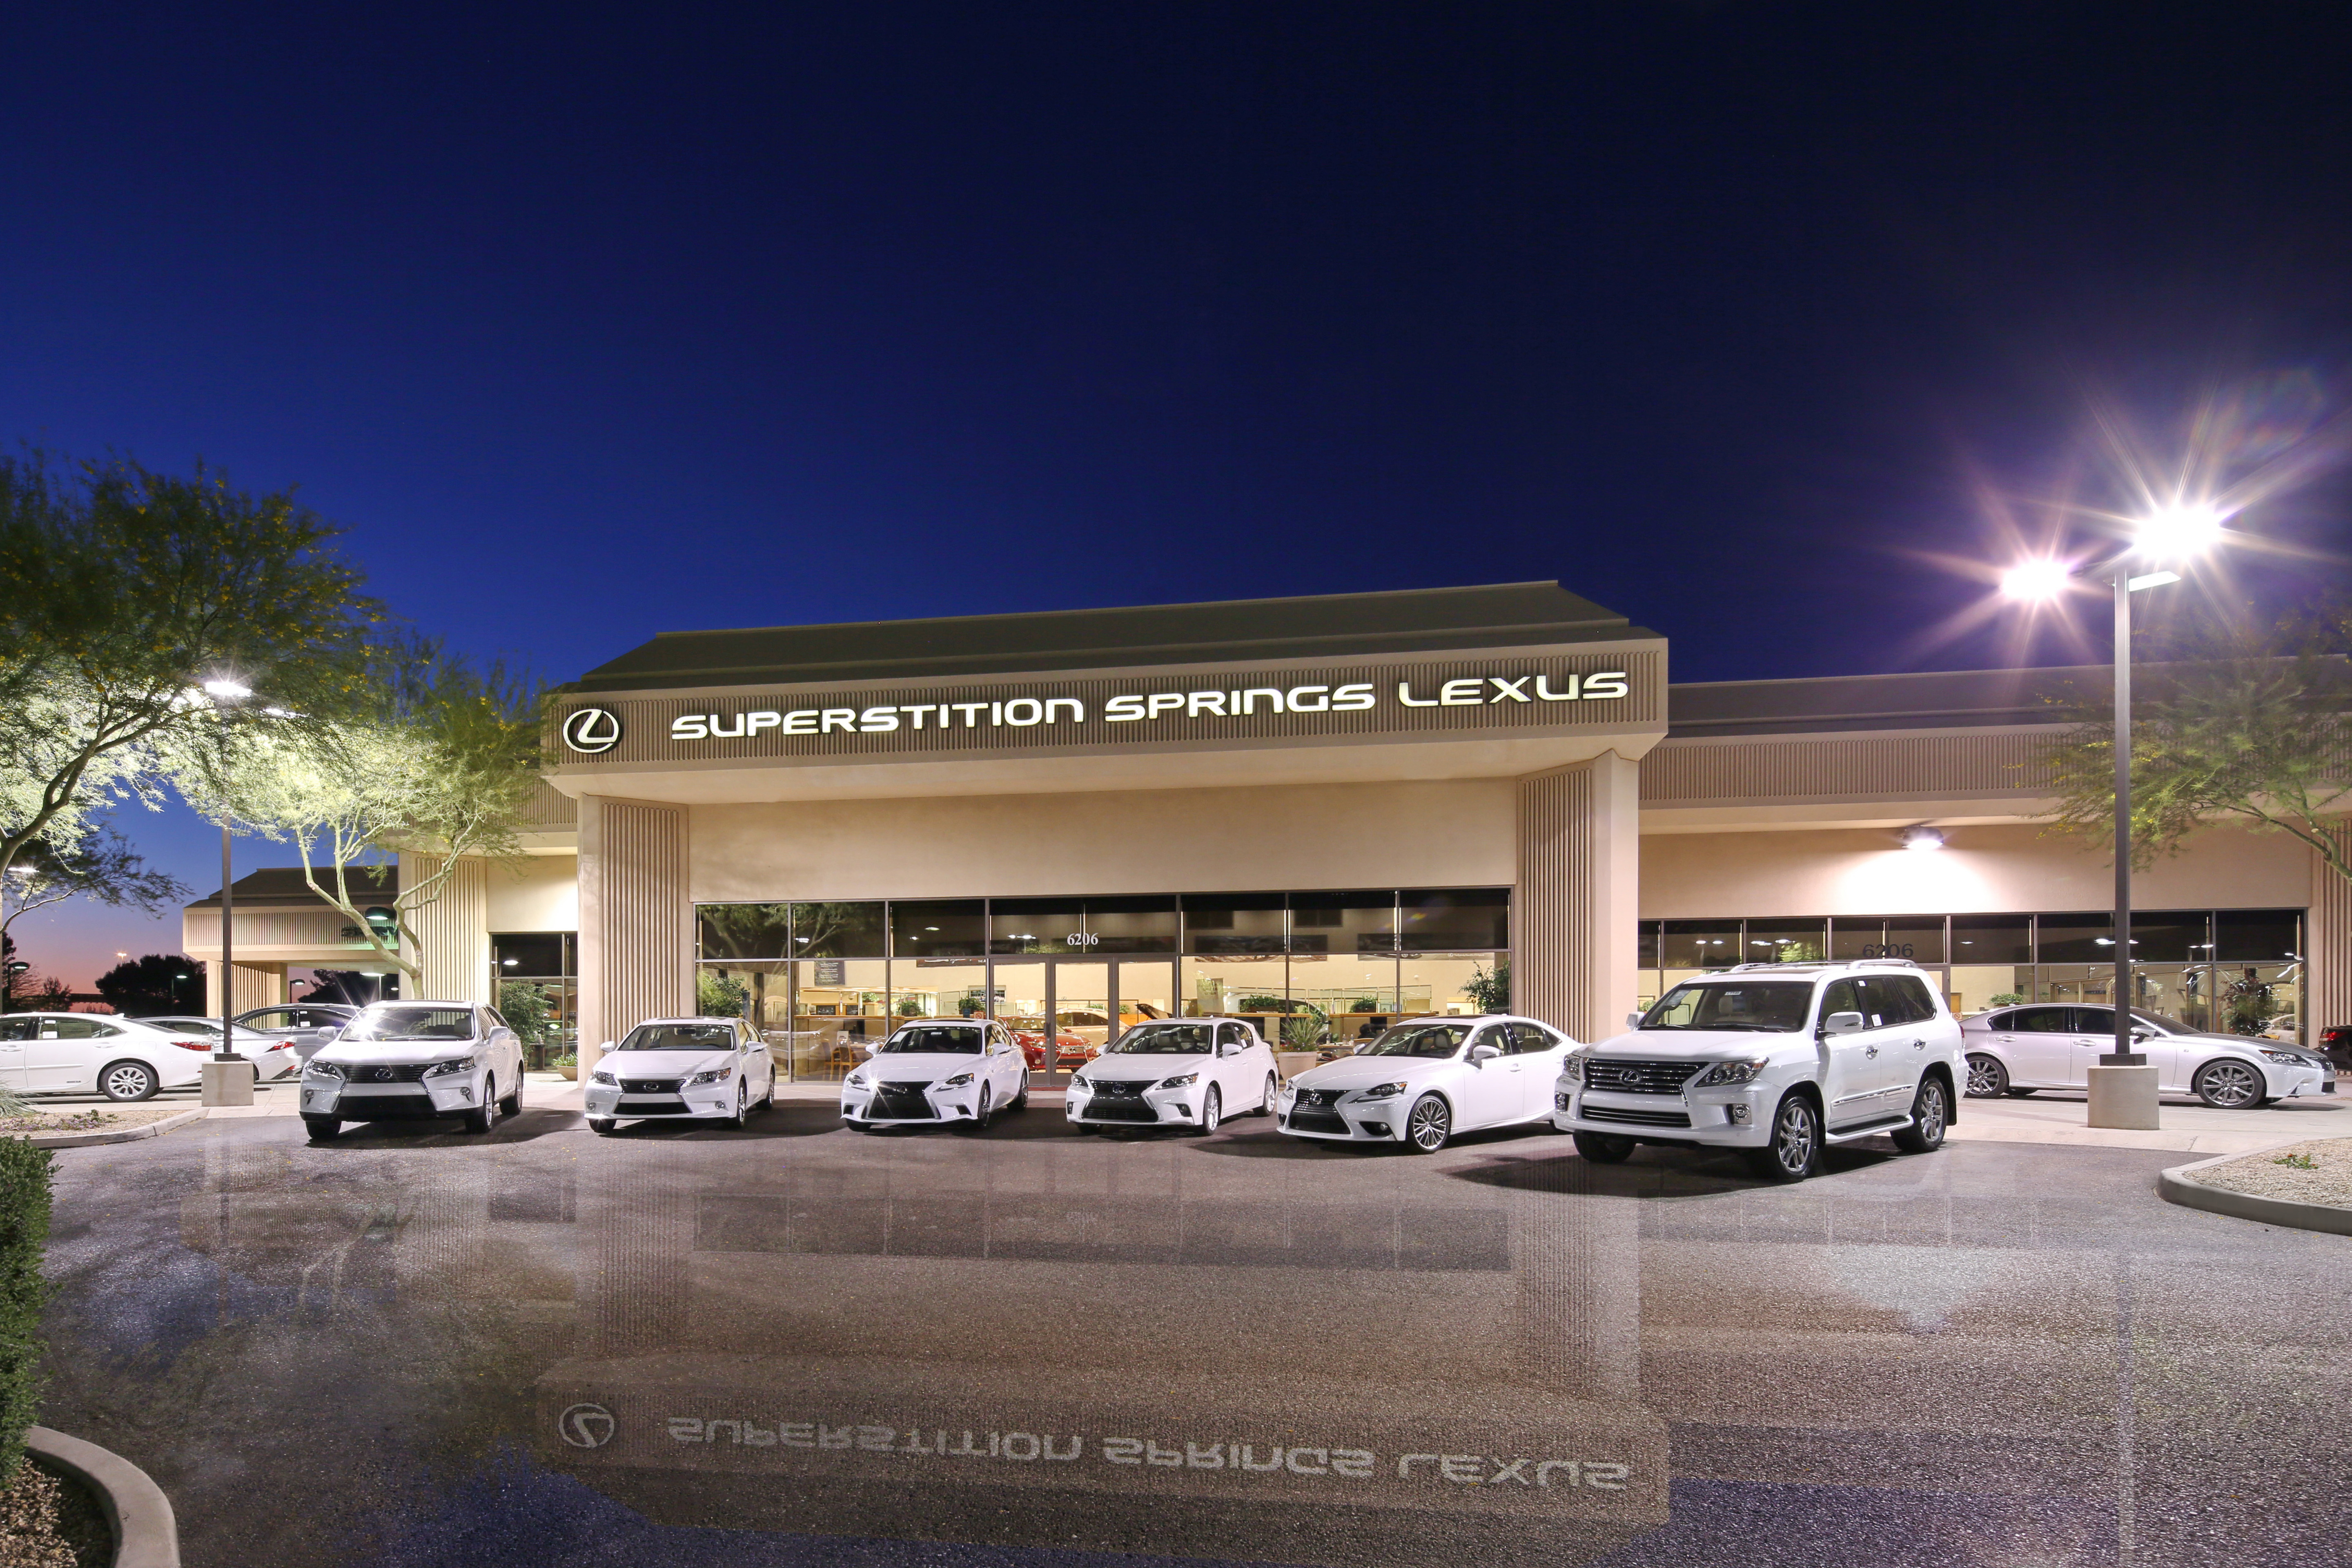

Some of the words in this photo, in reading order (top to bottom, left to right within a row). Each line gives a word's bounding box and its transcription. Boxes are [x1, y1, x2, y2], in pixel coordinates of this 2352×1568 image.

[672, 697, 1084, 740] SUPERSTITION
[1105, 683, 1376, 723] SPRINGS
[1398, 672, 1628, 706] LEXUS
[1067, 933, 1098, 945] 6206
[1863, 944, 1913, 958] 6206
